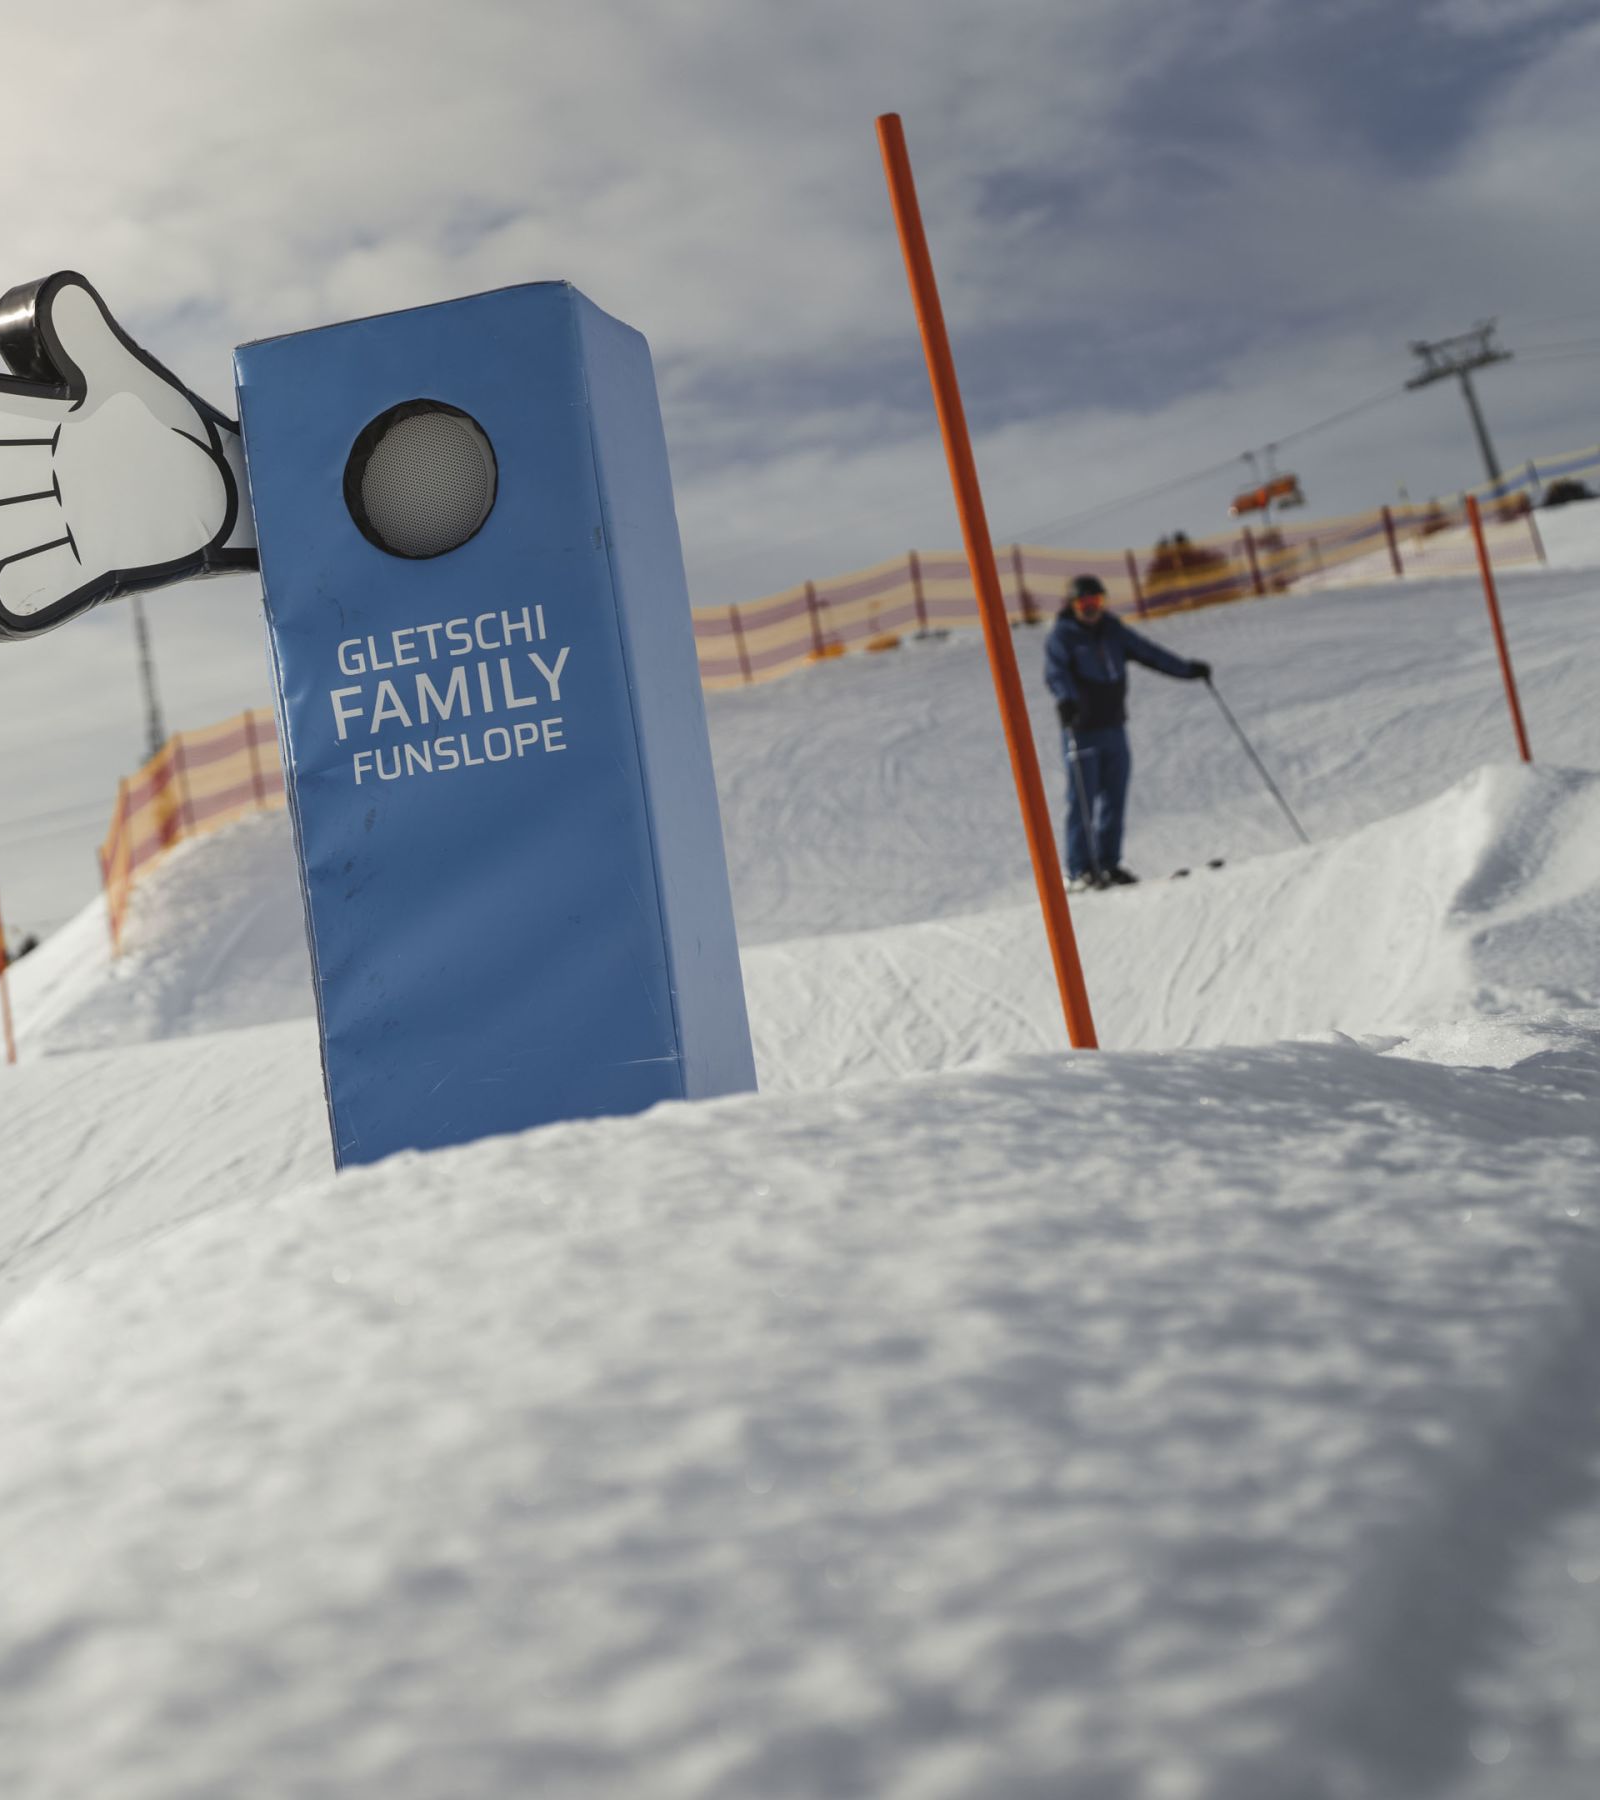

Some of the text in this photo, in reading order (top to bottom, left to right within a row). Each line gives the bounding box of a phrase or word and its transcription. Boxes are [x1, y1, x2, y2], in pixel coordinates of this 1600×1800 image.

[337, 605, 547, 676] GLETSCHI
[330, 647, 571, 741] FAMILY
[353, 717, 567, 785] FUNSLOPE
